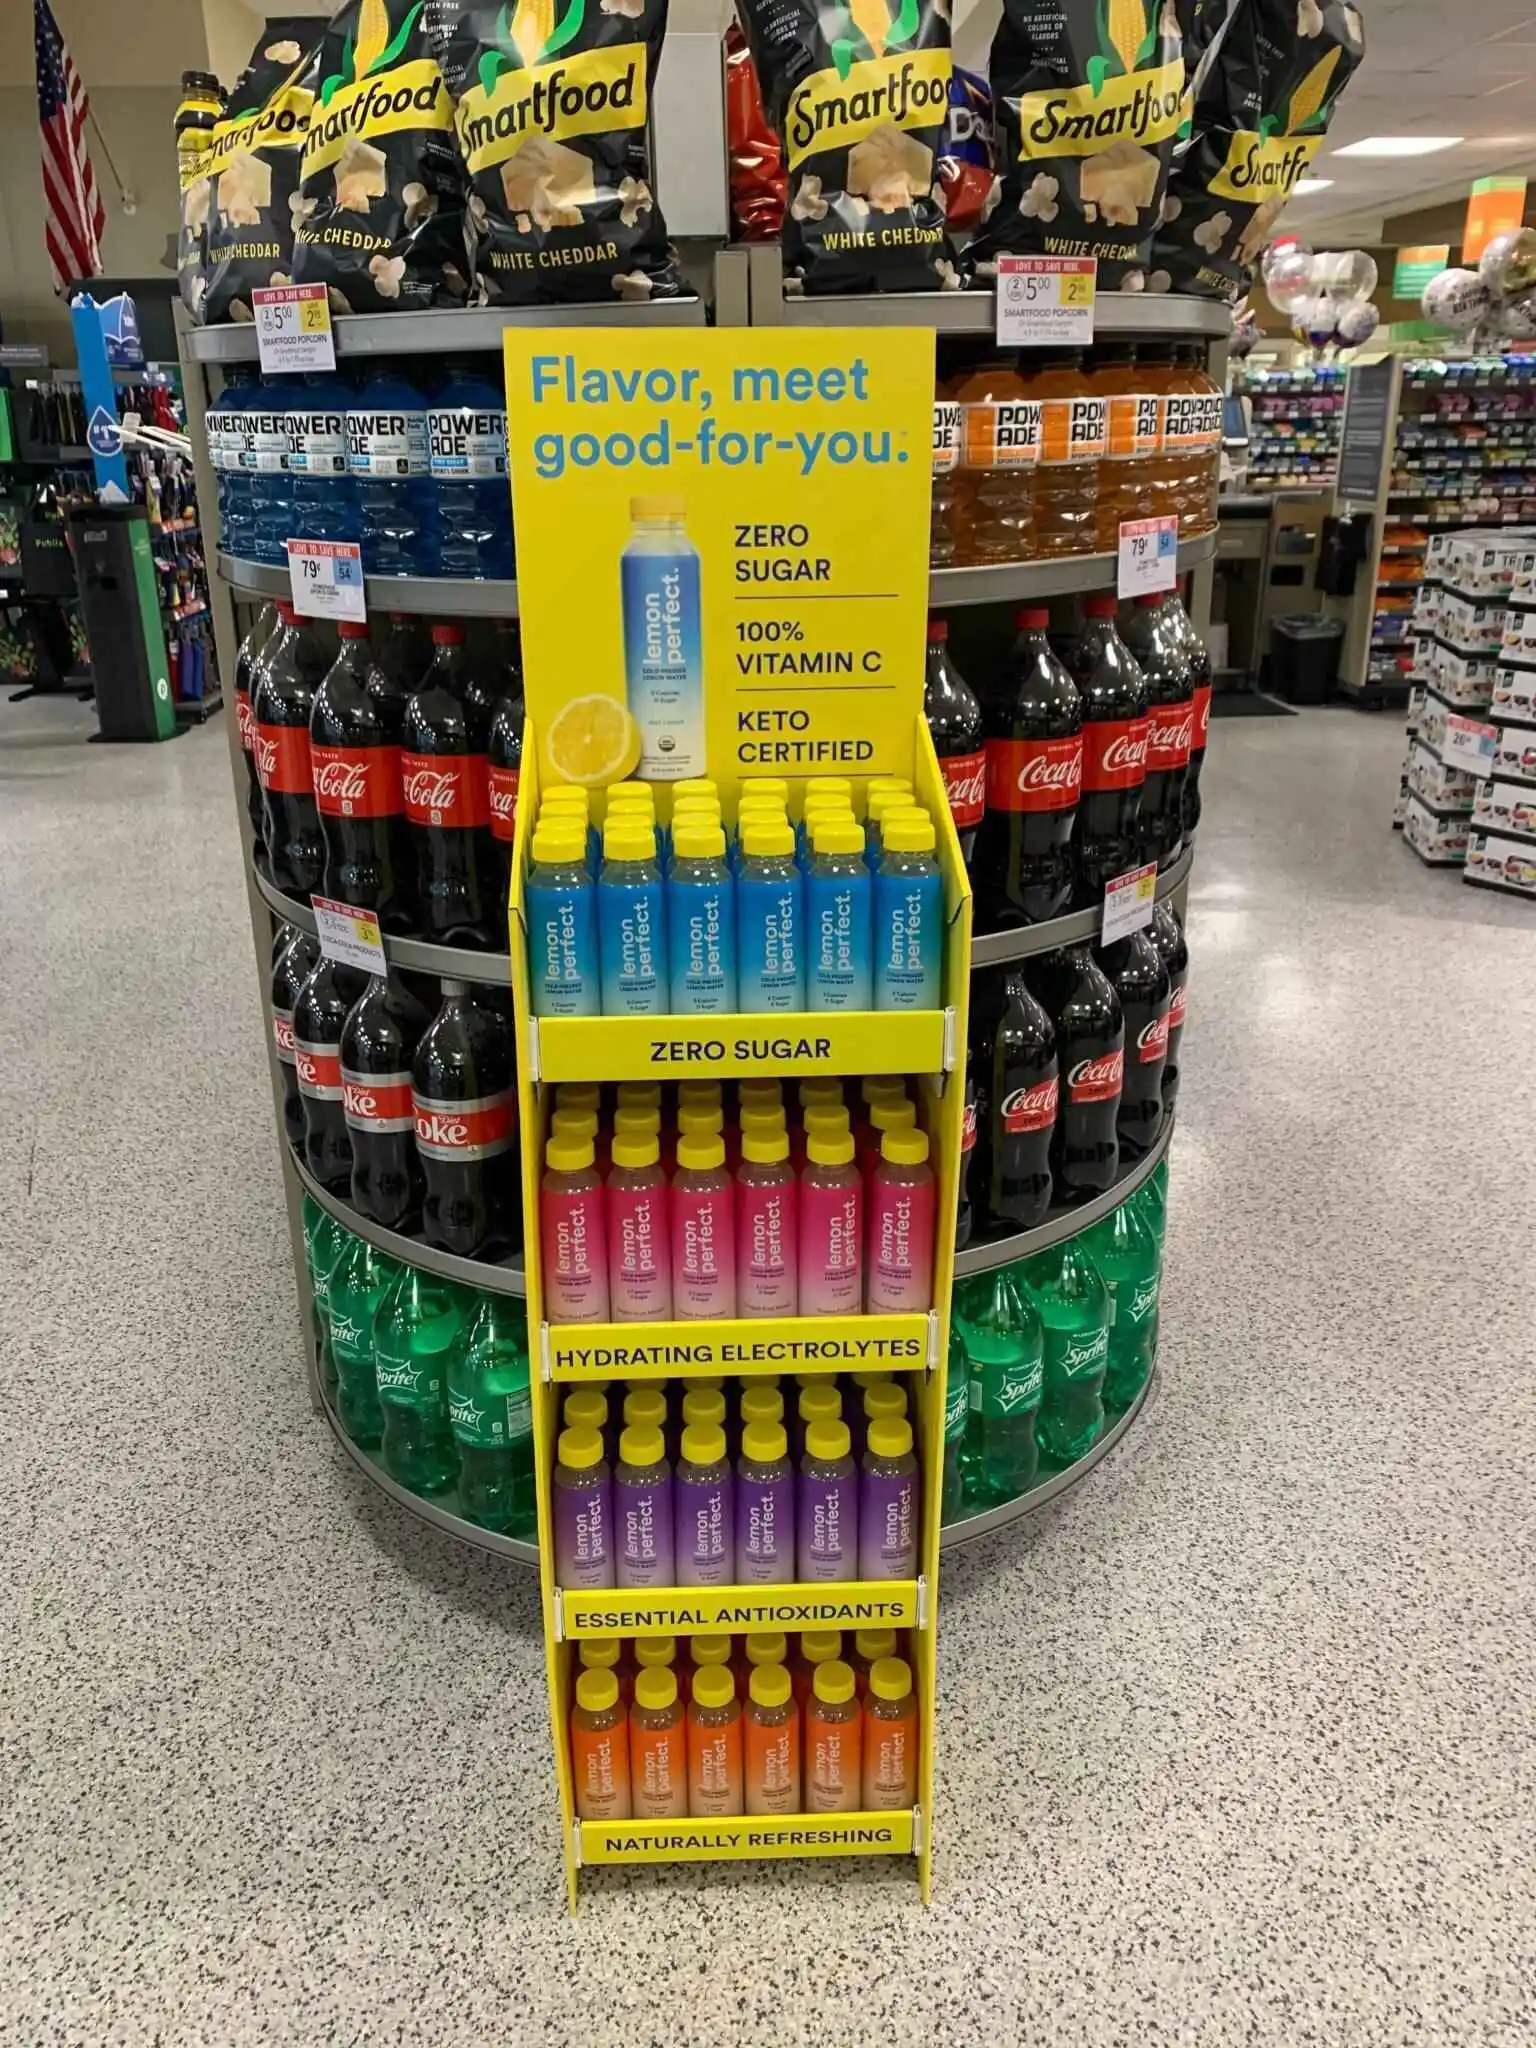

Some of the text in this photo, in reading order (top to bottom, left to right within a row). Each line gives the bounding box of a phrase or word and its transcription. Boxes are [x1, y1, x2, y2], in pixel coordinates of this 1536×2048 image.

[457, 63, 637, 159] Smartfood
[232, 243, 280, 259] CHEDDAR
[323, 227, 392, 251] CHEDDAR
[490, 242, 619, 270] WHITE CHEDDAR
[823, 226, 944, 251] WHITE CHEDDAR
[1045, 237, 1090, 257] WHITE
[1012, 279, 1020, 289] 2
[1015, 261, 1032, 272] LOVE
[1034, 261, 1043, 271] TO
[1044, 261, 1061, 271] SAVE
[263, 293, 276, 302] LOVE
[285, 291, 298, 300] SAVE
[1004, 308, 1088, 318] SMARTFOOD POPCORN
[531, 355, 870, 411] Flavor, meet
[429, 414, 502, 436] POWER
[431, 436, 467, 456] ADE
[997, 426, 1037, 447] ADE
[309, 544, 317, 555] TO
[734, 524, 809, 548] ZERO
[734, 558, 831, 582] SUGAR
[642, 592, 661, 666] lemon
[663, 566, 687, 665] perfect.
[735, 621, 804, 643] 100%
[736, 650, 882, 675] VITAMIN C
[738, 710, 810, 732] KETO
[738, 741, 874, 764] CERTIFIED
[313, 762, 371, 799] Cola
[402, 770, 462, 809] Cola
[545, 921, 561, 981] lemon
[558, 899, 580, 980] perfect.
[620, 918, 637, 978] lemon
[633, 895, 656, 977] perfect.
[686, 916, 703, 977] lemon
[703, 895, 724, 976] perfect.
[761, 914, 778, 974] lemon
[778, 891, 796, 974] perfect.
[818, 910, 834, 971] lemon
[834, 889, 853, 972] perfect.
[888, 909, 905, 970] lemon
[904, 888, 924, 970] perfect.
[651, 1038, 831, 1062] ZERO SUGAR
[555, 1222, 569, 1275] lemon
[569, 1202, 590, 1275] perfect.
[620, 1218, 635, 1272] lemon
[634, 1199, 656, 1272] perfect.
[683, 1220, 697, 1275] lemon
[697, 1201, 719, 1275] perfect.
[751, 1214, 765, 1267] lemon
[765, 1195, 785, 1267] perfect.
[826, 1216, 842, 1269] lemon
[842, 1194, 857, 1269] perfect.
[877, 1212, 893, 1267] lemon
[895, 1196, 913, 1268] perfect.
[556, 1338, 920, 1368] HYDRATING ELECTROLYTES
[573, 1513, 588, 1560] lemon
[588, 1493, 604, 1558] perfect.
[625, 1511, 638, 1558] lemon
[638, 1495, 657, 1559] perfect.
[693, 1509, 708, 1557] lemon
[709, 1491, 725, 1555] perfect.
[746, 1507, 760, 1554] lemon
[761, 1491, 777, 1555] perfect.
[810, 1504, 825, 1552] lemon
[825, 1488, 843, 1552] perfect.
[882, 1502, 898, 1550] lemon
[899, 1483, 914, 1547] perfect.
[575, 1602, 904, 1629] ESSENTIAL ANTIOXIDANTS
[606, 1828, 893, 1852] NATURALLY REFRESHING
